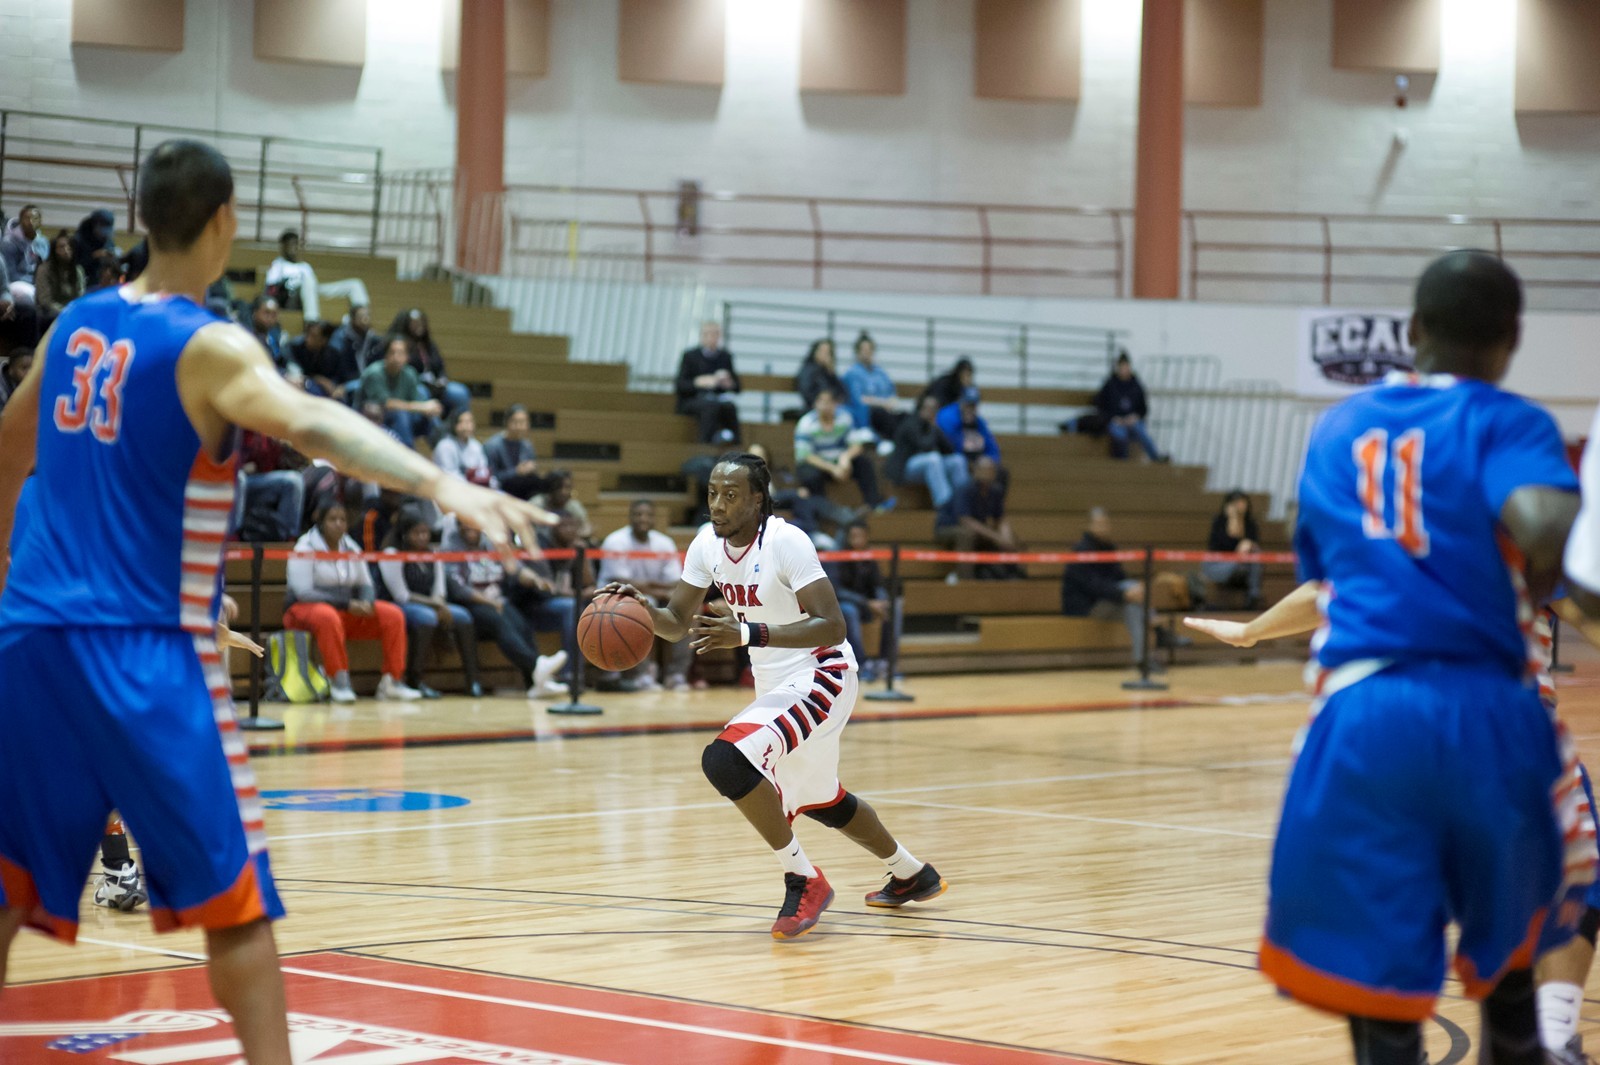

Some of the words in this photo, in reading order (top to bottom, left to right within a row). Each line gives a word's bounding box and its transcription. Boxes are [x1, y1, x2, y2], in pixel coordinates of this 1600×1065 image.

[54, 327, 136, 444] 33
[1352, 427, 1431, 559] 11
[288, 1017, 590, 1065] ONFERENCE
